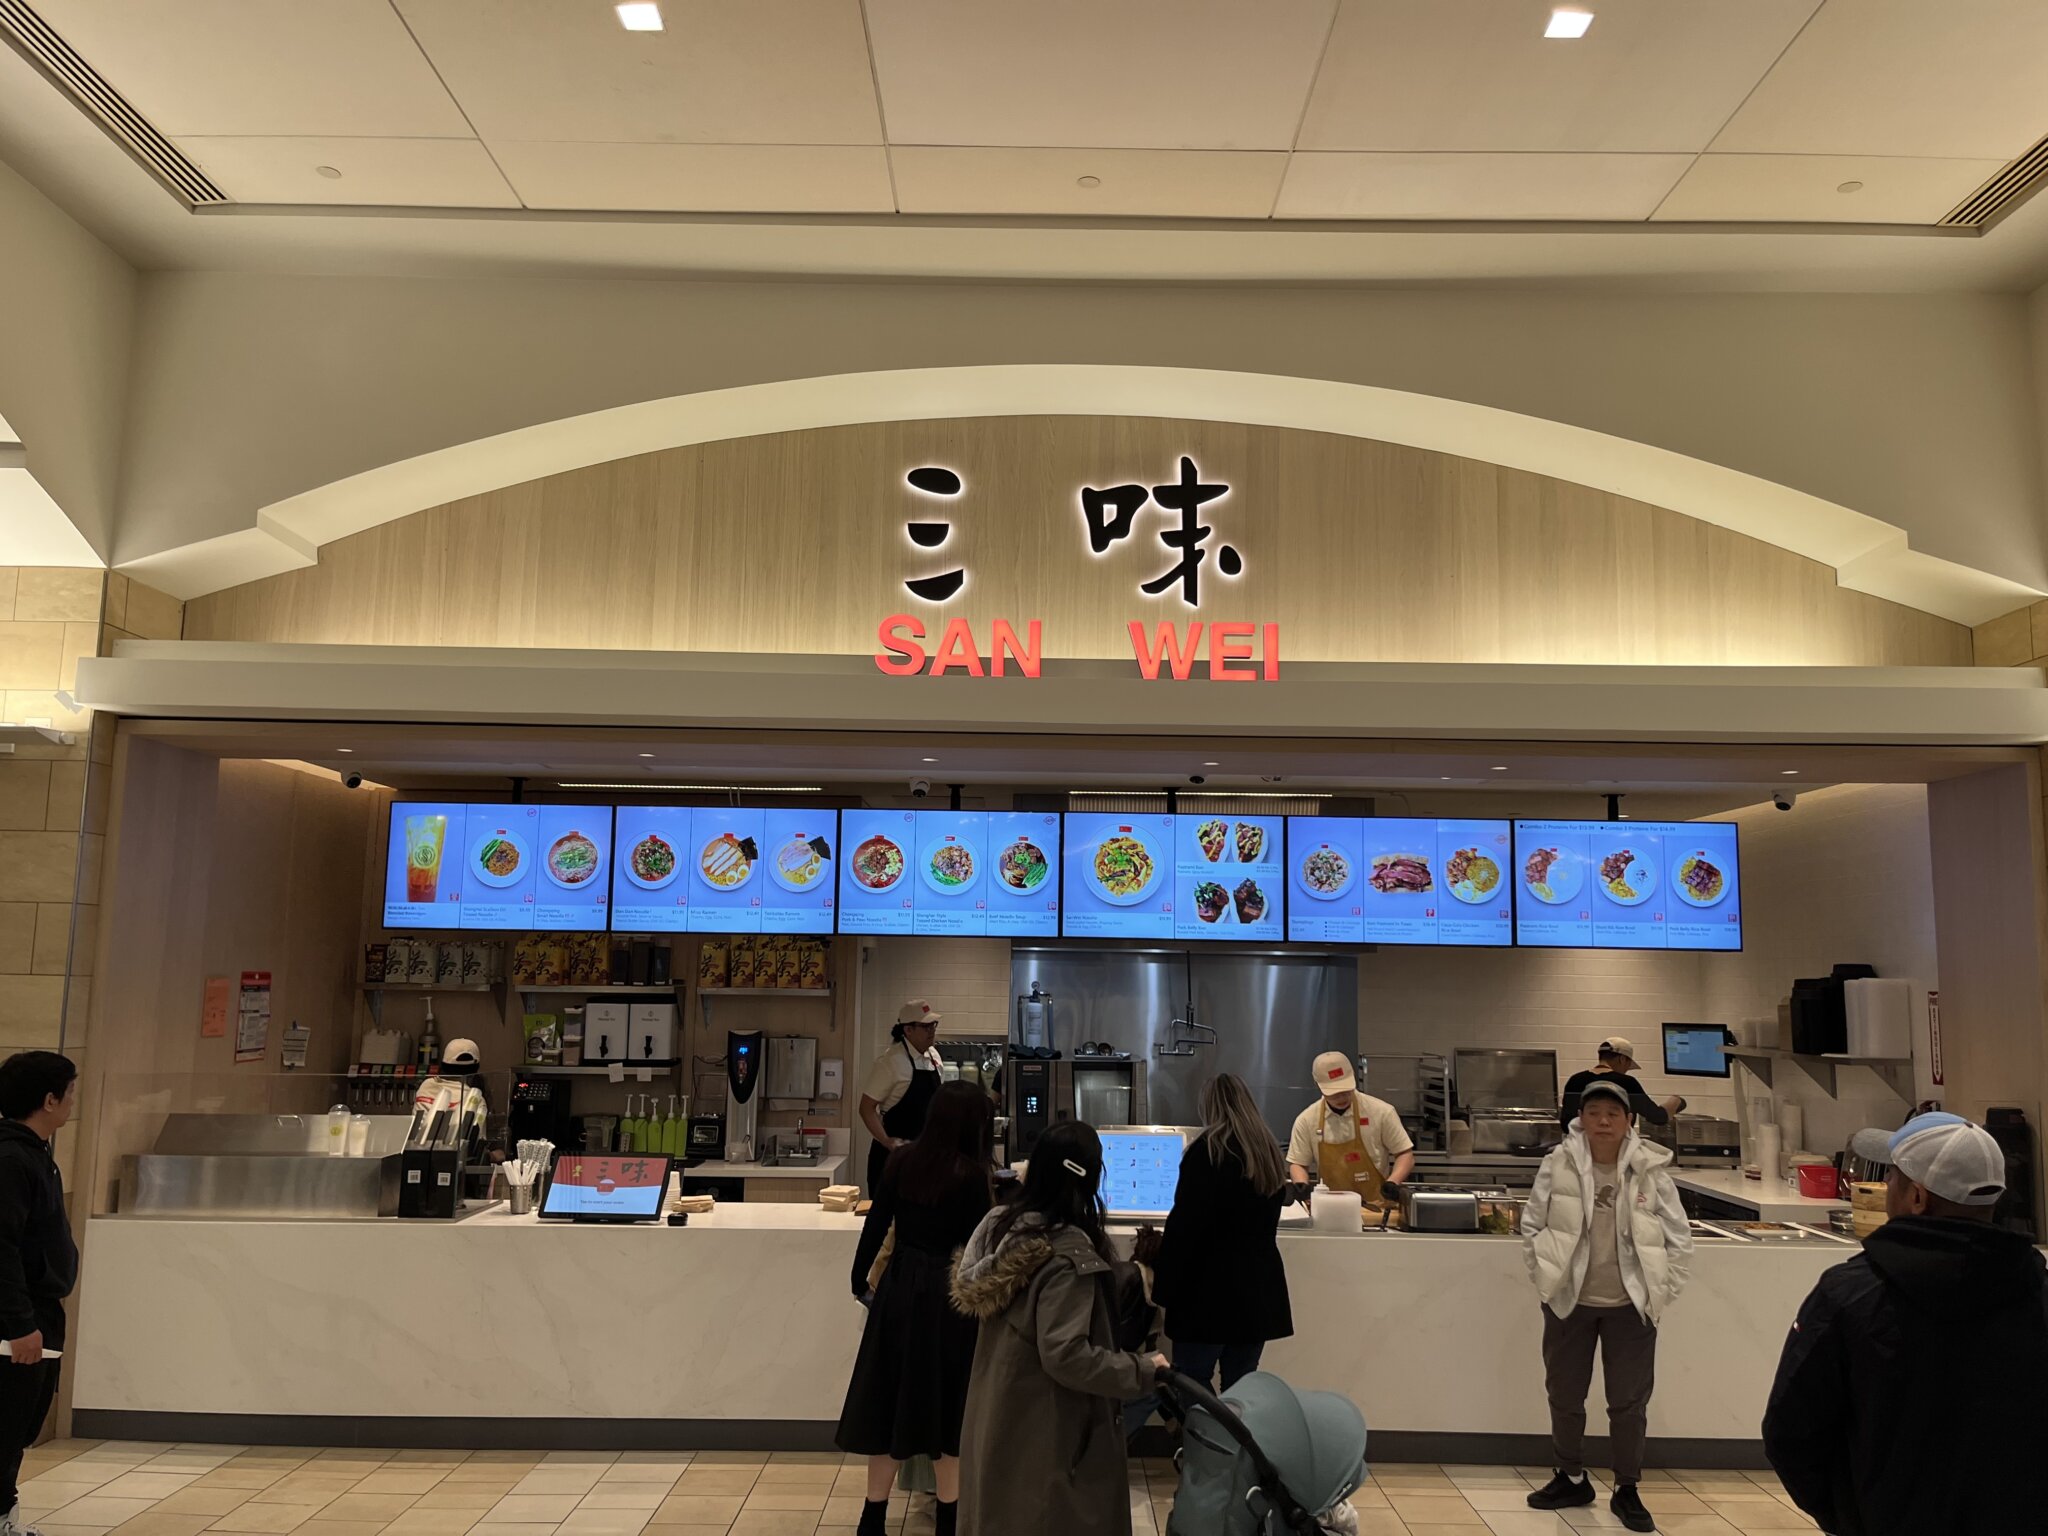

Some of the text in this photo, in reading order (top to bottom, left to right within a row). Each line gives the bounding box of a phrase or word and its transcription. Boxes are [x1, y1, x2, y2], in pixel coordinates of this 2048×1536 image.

[904, 455, 1243, 608] 三味
[874, 613, 1280, 681] SAN WEI
